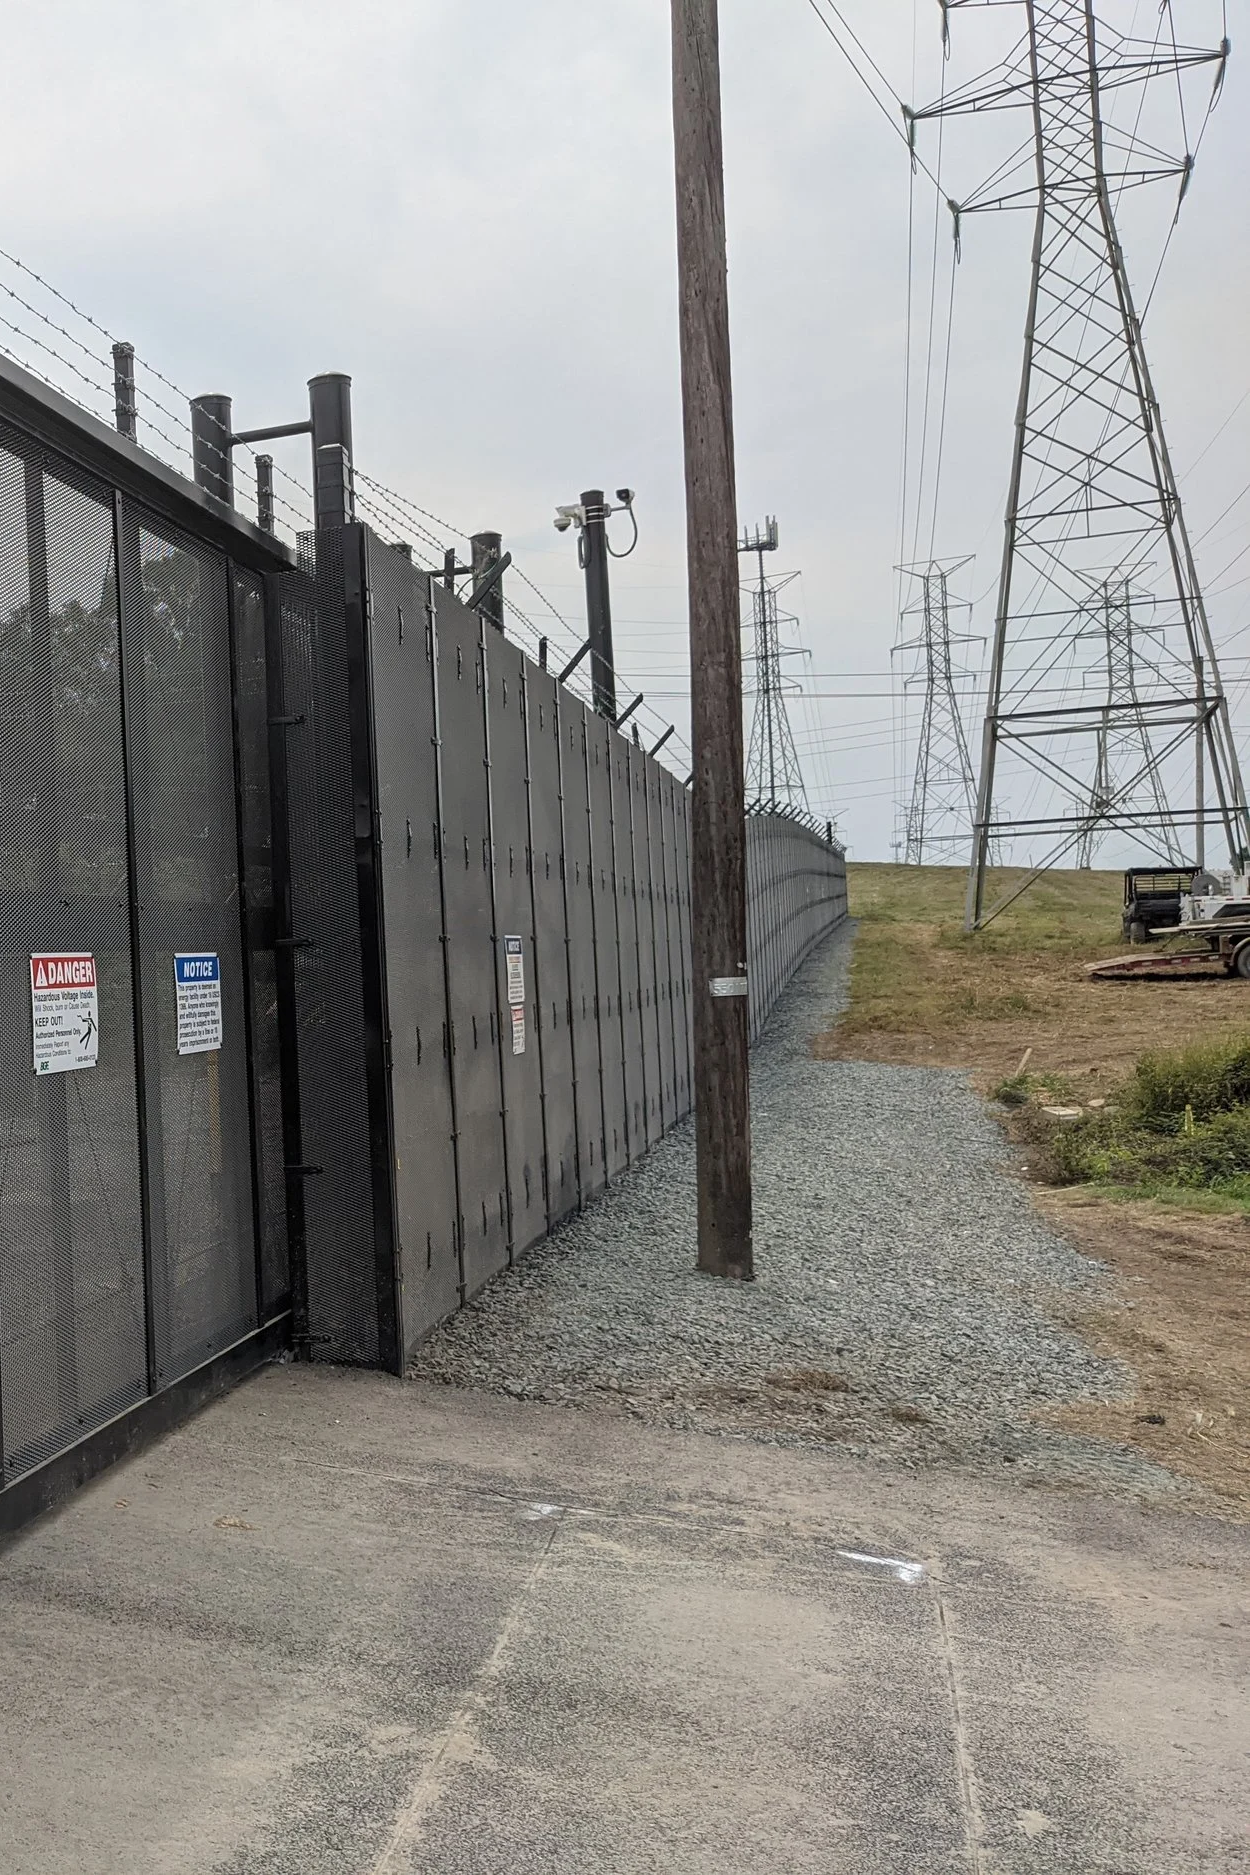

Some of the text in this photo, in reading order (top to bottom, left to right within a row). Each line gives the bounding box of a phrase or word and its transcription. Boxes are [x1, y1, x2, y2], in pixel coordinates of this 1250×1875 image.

[47, 961, 93, 985] DANGER
[183, 961, 213, 978] NOTICE
[34, 990, 94, 1002] Hazardous Voltage Inside.
[35, 1015, 63, 1027] KEEP OUT!
